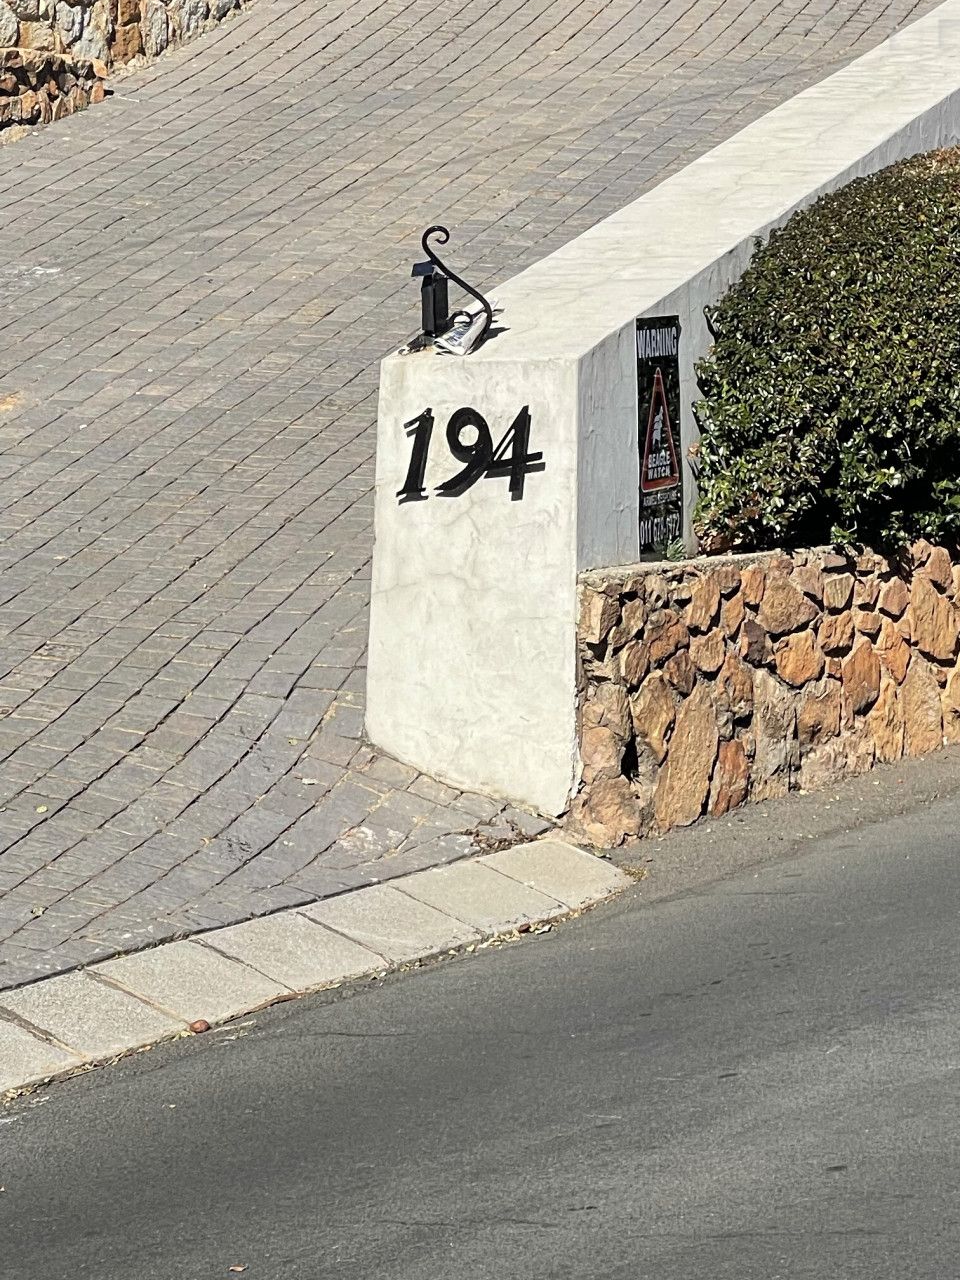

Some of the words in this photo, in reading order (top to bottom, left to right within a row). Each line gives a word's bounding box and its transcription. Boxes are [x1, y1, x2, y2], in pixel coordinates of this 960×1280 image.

[637, 327, 677, 358] WARNING
[395, 405, 546, 505] 194
[648, 451, 671, 468] BEAGLE
[648, 465, 671, 480] WATCH
[640, 519, 652, 545] 011
